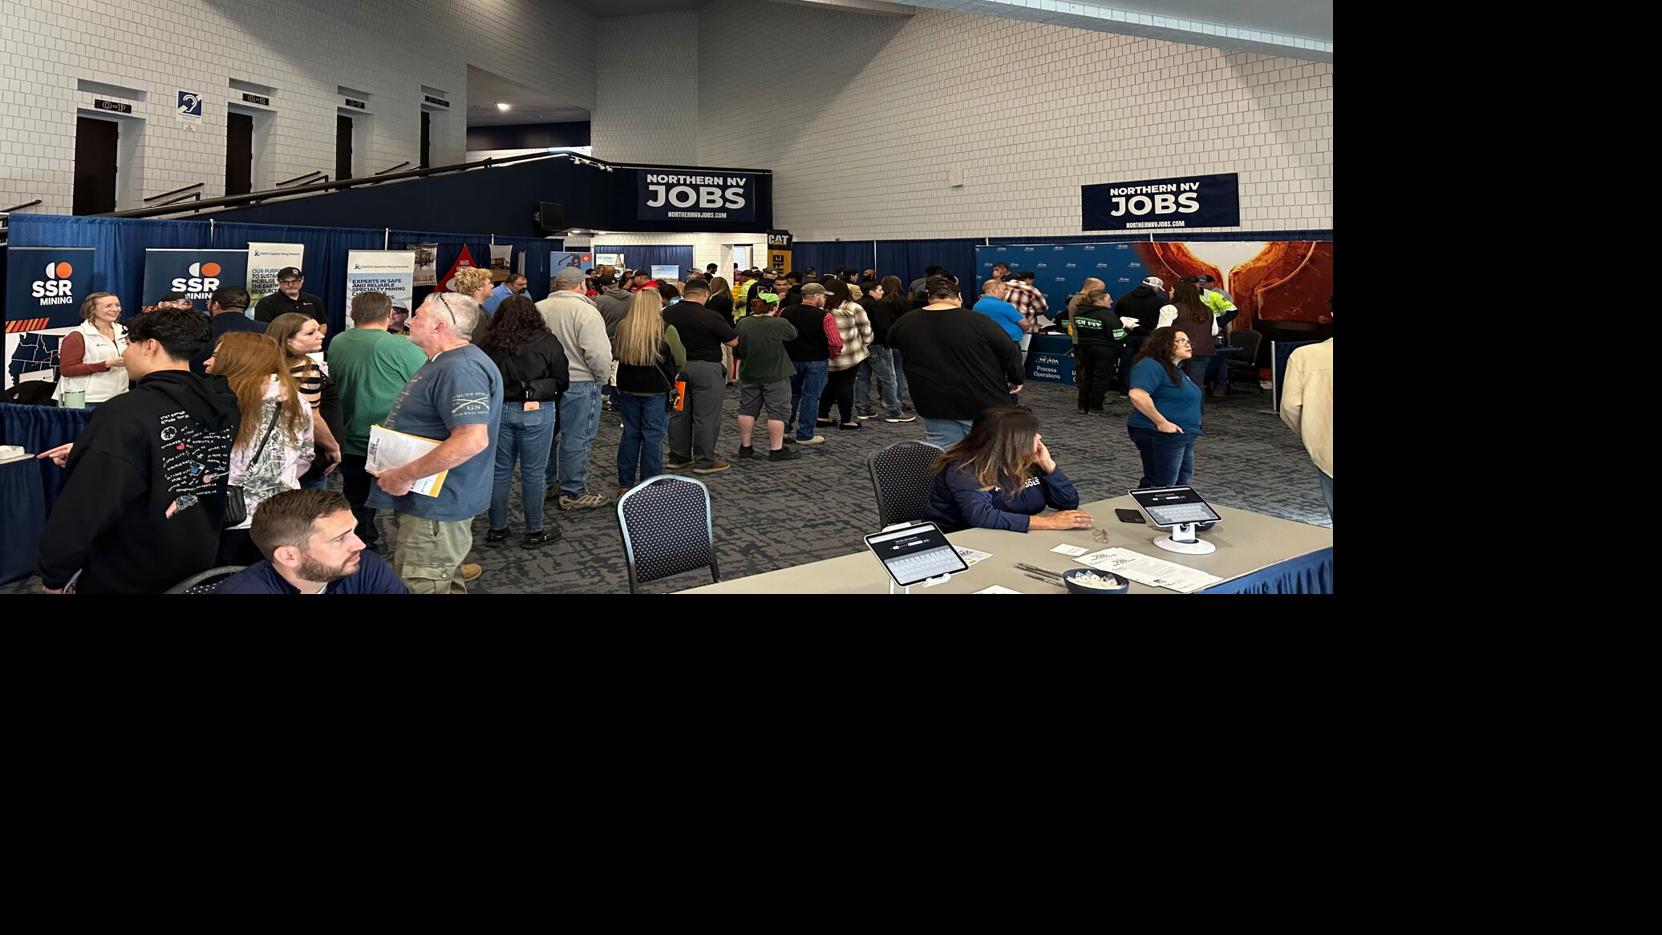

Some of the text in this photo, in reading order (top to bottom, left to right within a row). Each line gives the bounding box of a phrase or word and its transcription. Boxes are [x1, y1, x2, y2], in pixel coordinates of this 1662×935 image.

[646, 174, 747, 186] NORTHERN NV
[1110, 182, 1200, 196] NORTHERN NV
[646, 185, 746, 209] JOBS
[1110, 192, 1200, 217] JOBS
[768, 234, 789, 246] CAT
[32, 280, 72, 298] SSR
[171, 278, 220, 292] SSR
[40, 296, 73, 306] MINING
[184, 292, 213, 300] ININ
[1033, 371, 1061, 379] Operations
